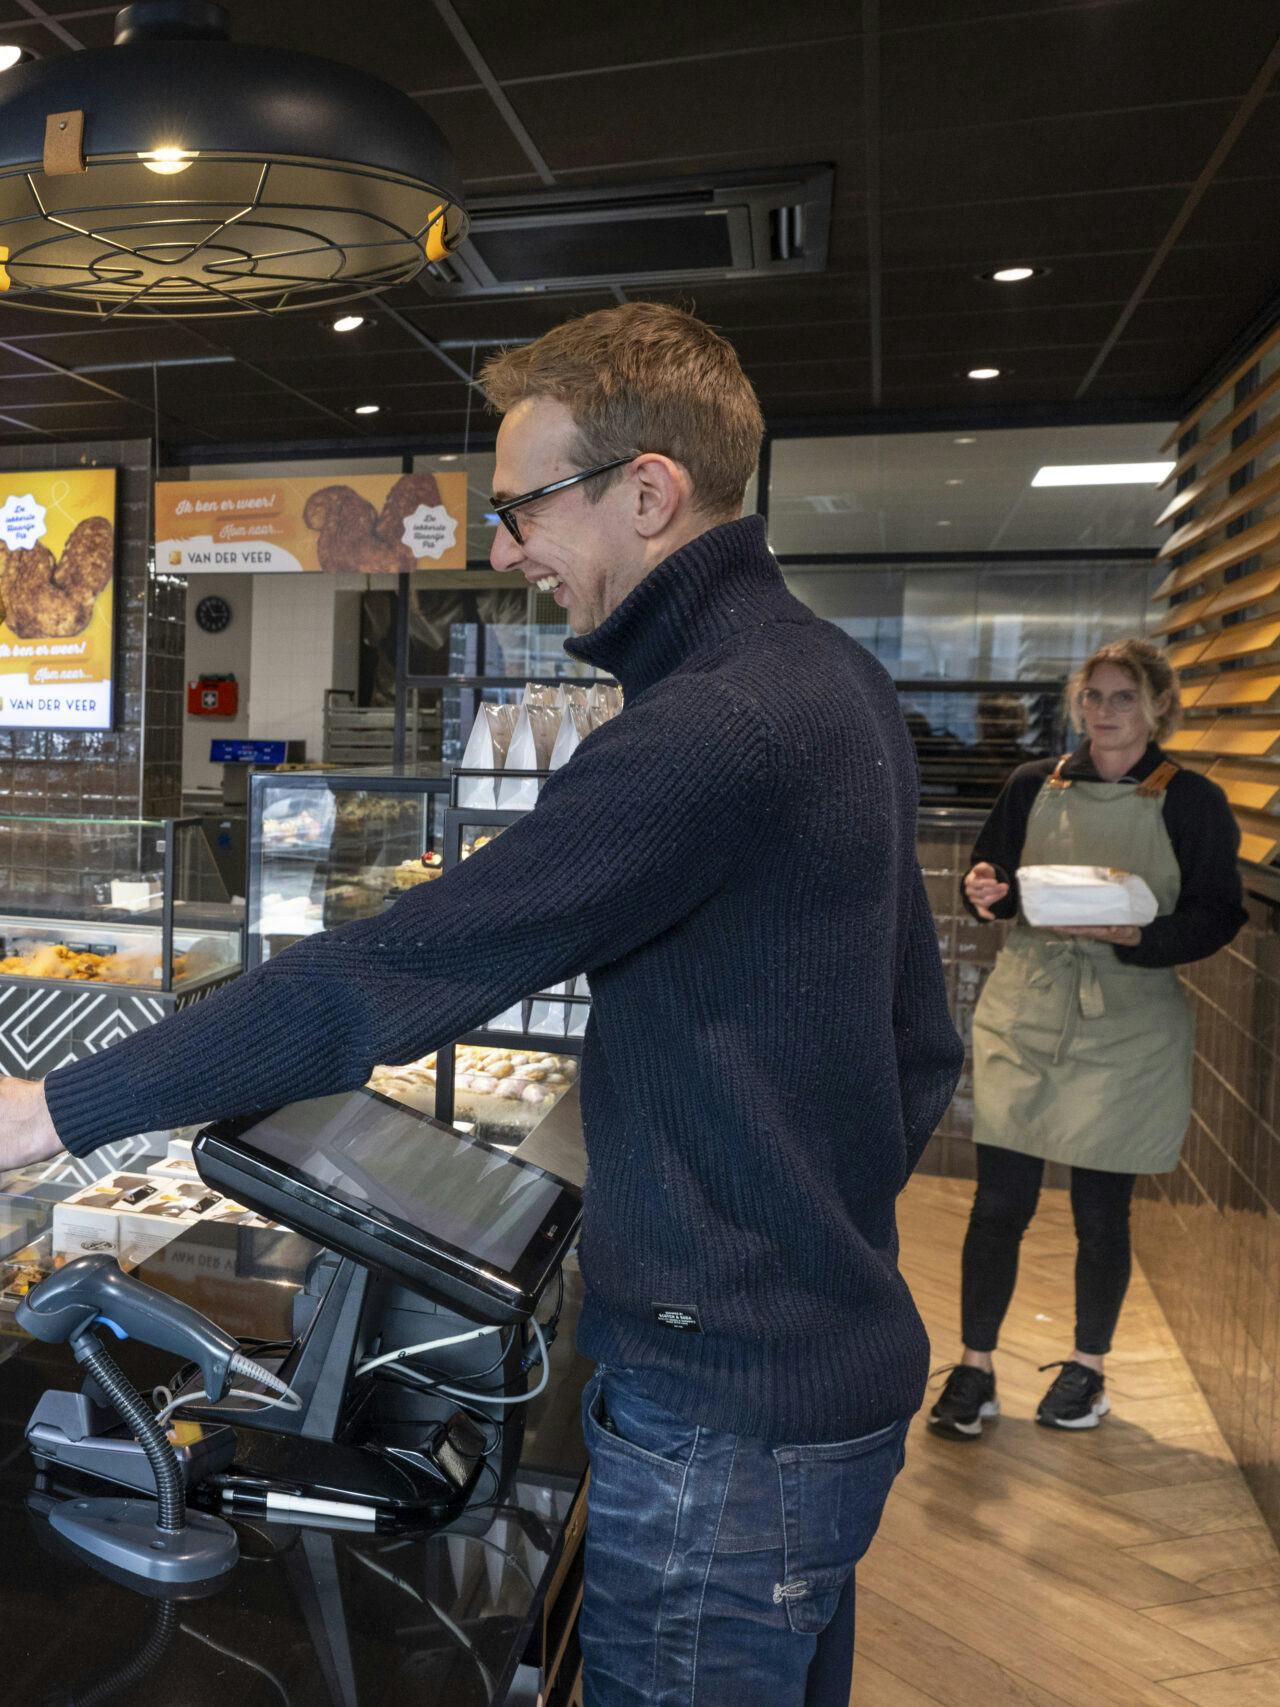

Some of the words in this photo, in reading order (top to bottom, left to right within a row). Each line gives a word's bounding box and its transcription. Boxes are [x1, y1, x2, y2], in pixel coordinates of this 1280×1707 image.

[195, 500, 220, 512] ben
[221, 499, 235, 511] er
[236, 494, 276, 510] weer!
[187, 552, 211, 563] VAN
[215, 552, 237, 563] DER
[241, 551, 272, 563] VEER
[12, 644, 34, 657] ben
[35, 645, 49, 656] er
[9, 698, 34, 710] VAN
[38, 699, 61, 711] DER
[66, 699, 97, 711] VEER
